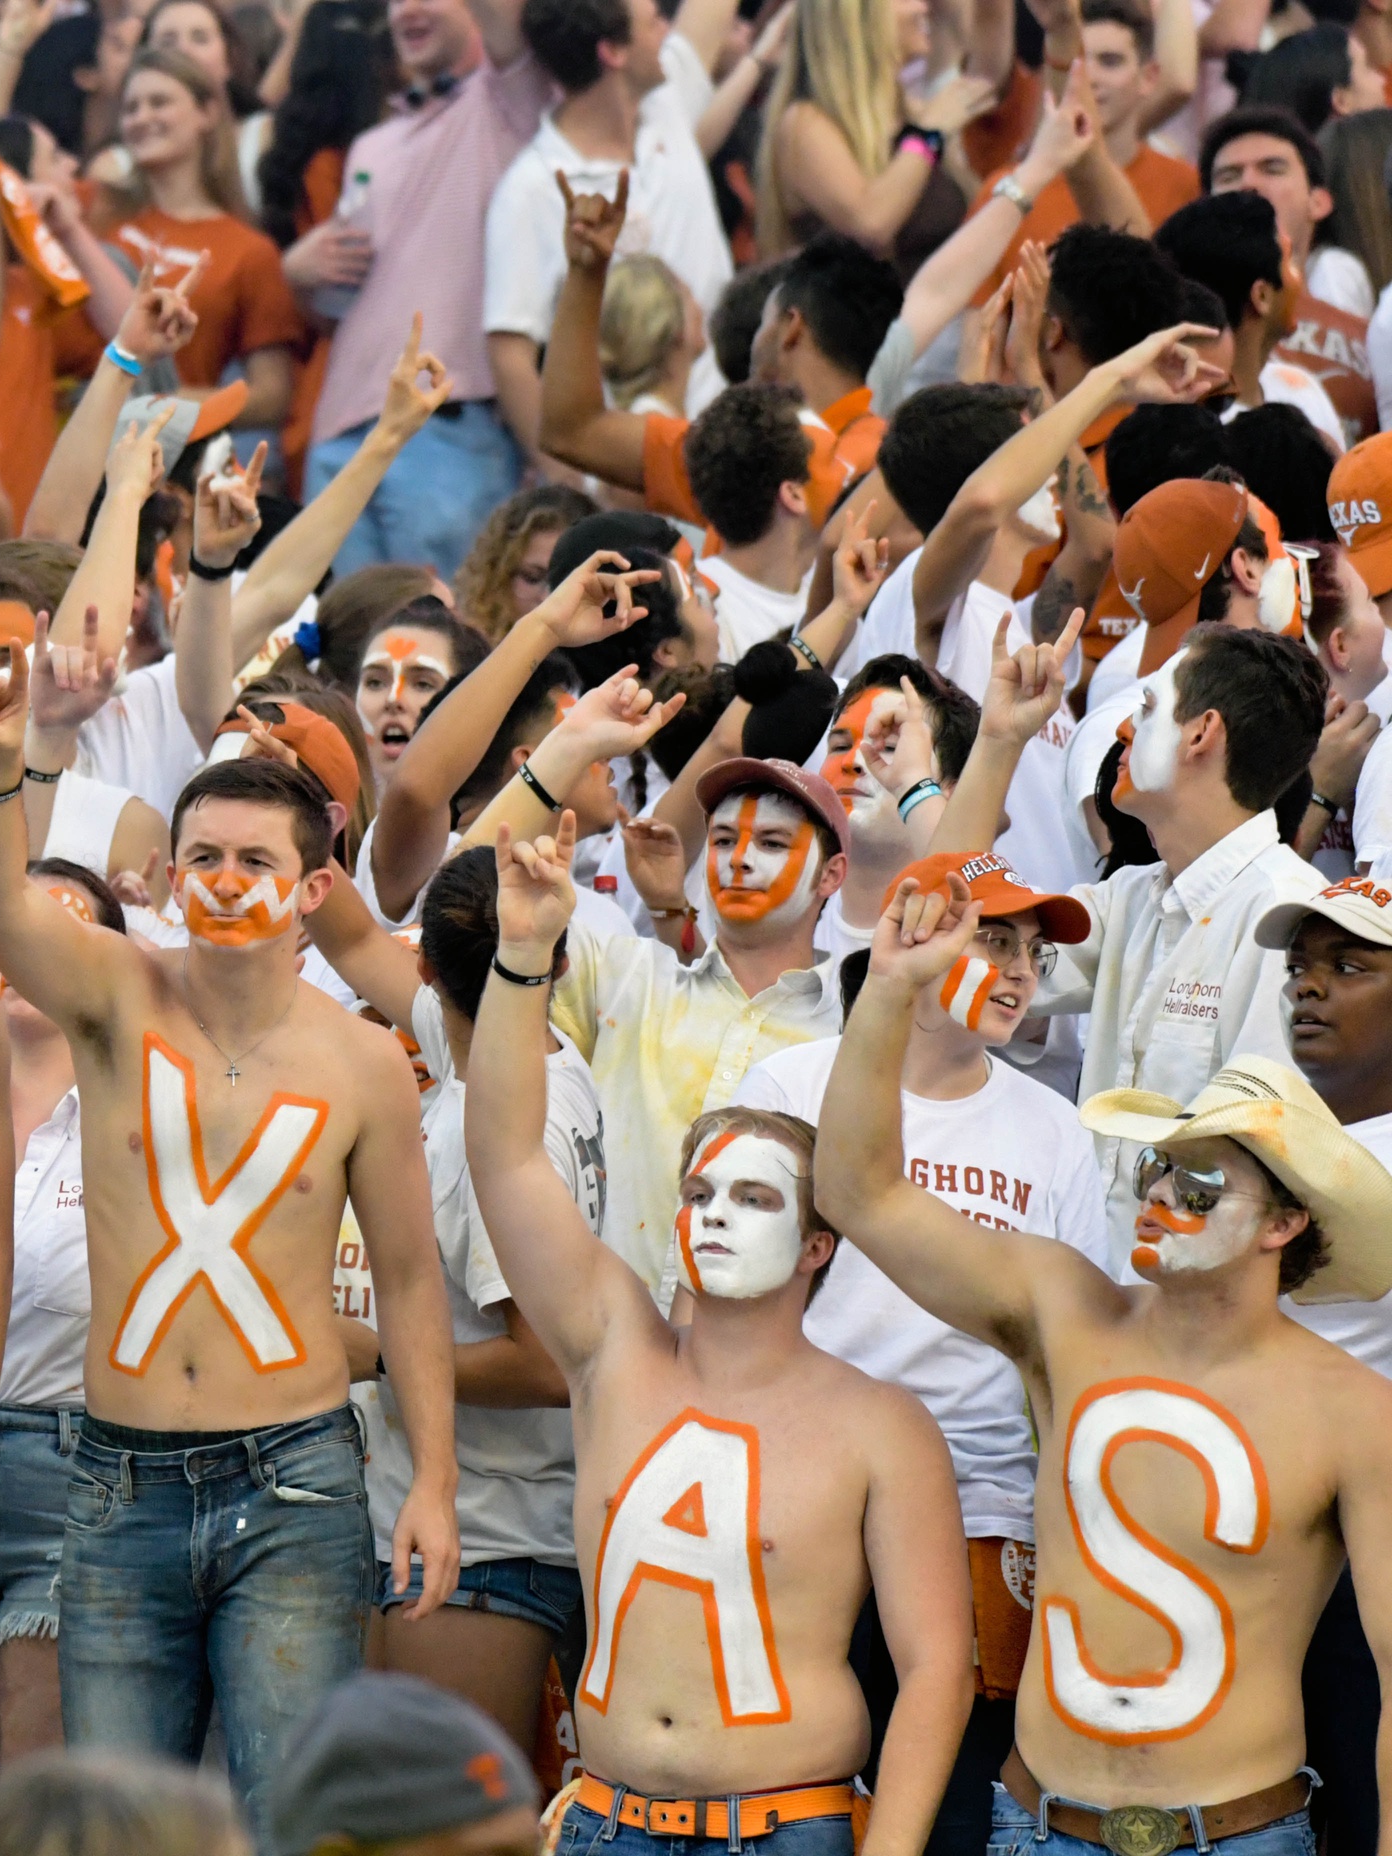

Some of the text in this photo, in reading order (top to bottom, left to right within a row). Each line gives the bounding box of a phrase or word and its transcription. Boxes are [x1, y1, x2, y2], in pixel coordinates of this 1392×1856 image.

[1162, 997, 1219, 1020] Hellraisers
[1168, 977, 1222, 999] Longhorn
[109, 1031, 330, 1377] X
[580, 1407, 792, 1727] A
[1042, 1375, 1270, 1746] S
